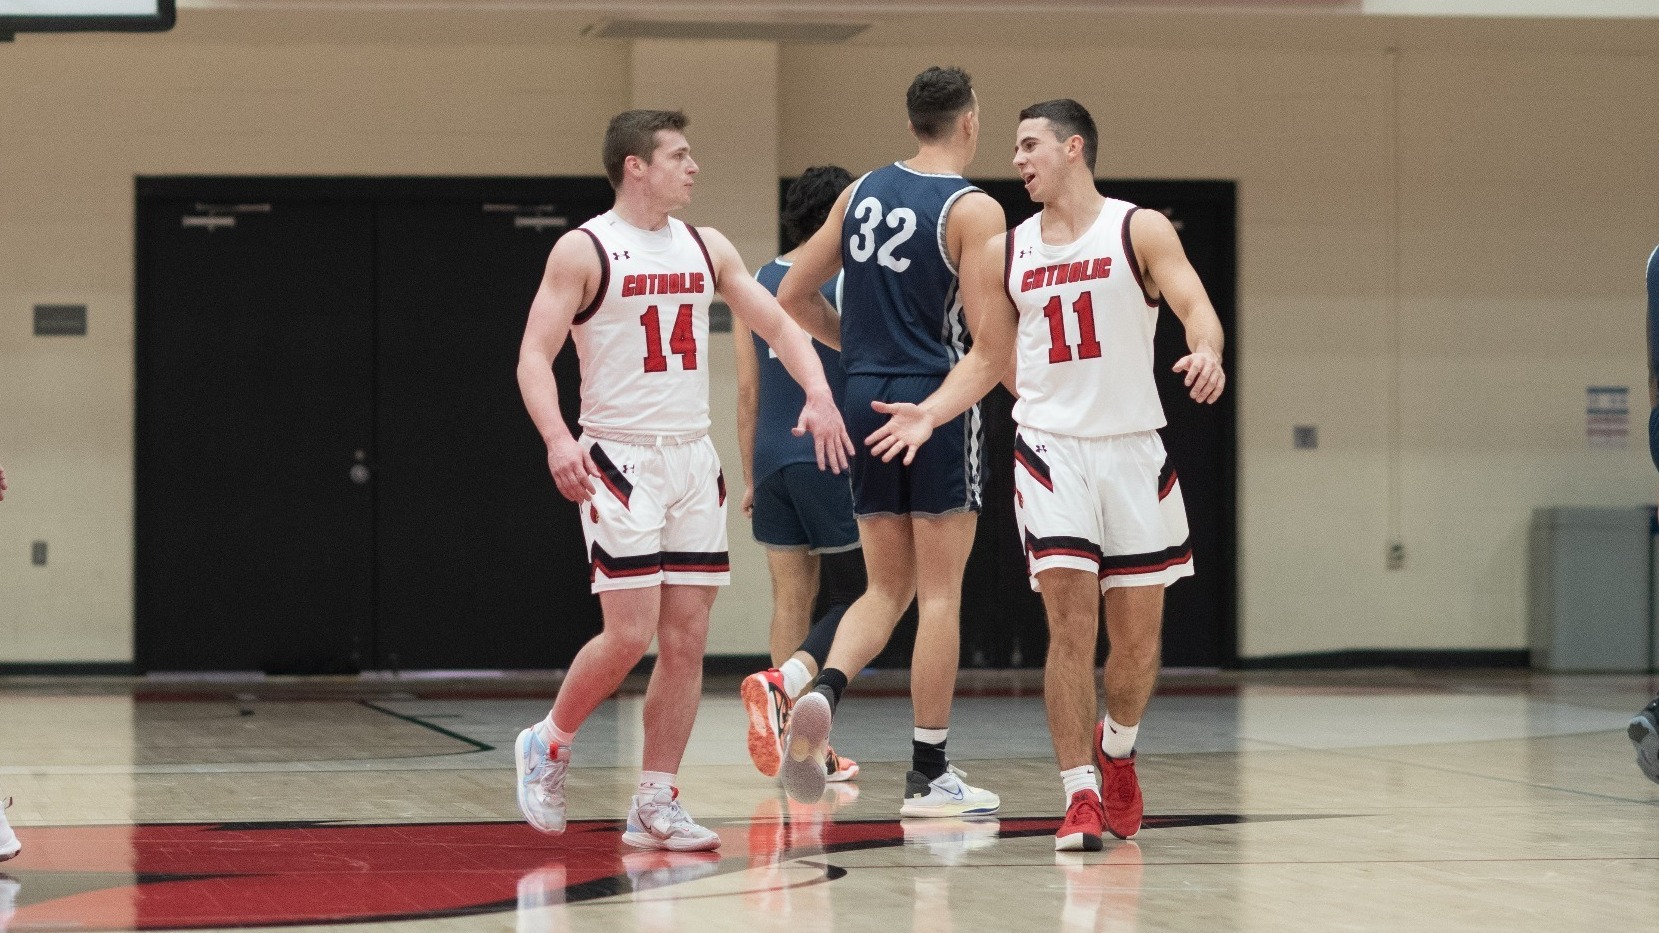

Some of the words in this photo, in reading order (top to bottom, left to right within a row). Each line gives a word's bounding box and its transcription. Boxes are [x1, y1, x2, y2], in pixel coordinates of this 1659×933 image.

[850, 197, 917, 272] 32
[621, 272, 705, 297] CATHOLIC
[1020, 257, 1112, 292] CATHOLIC
[640, 304, 697, 373] 14
[1043, 291, 1102, 364] 11
